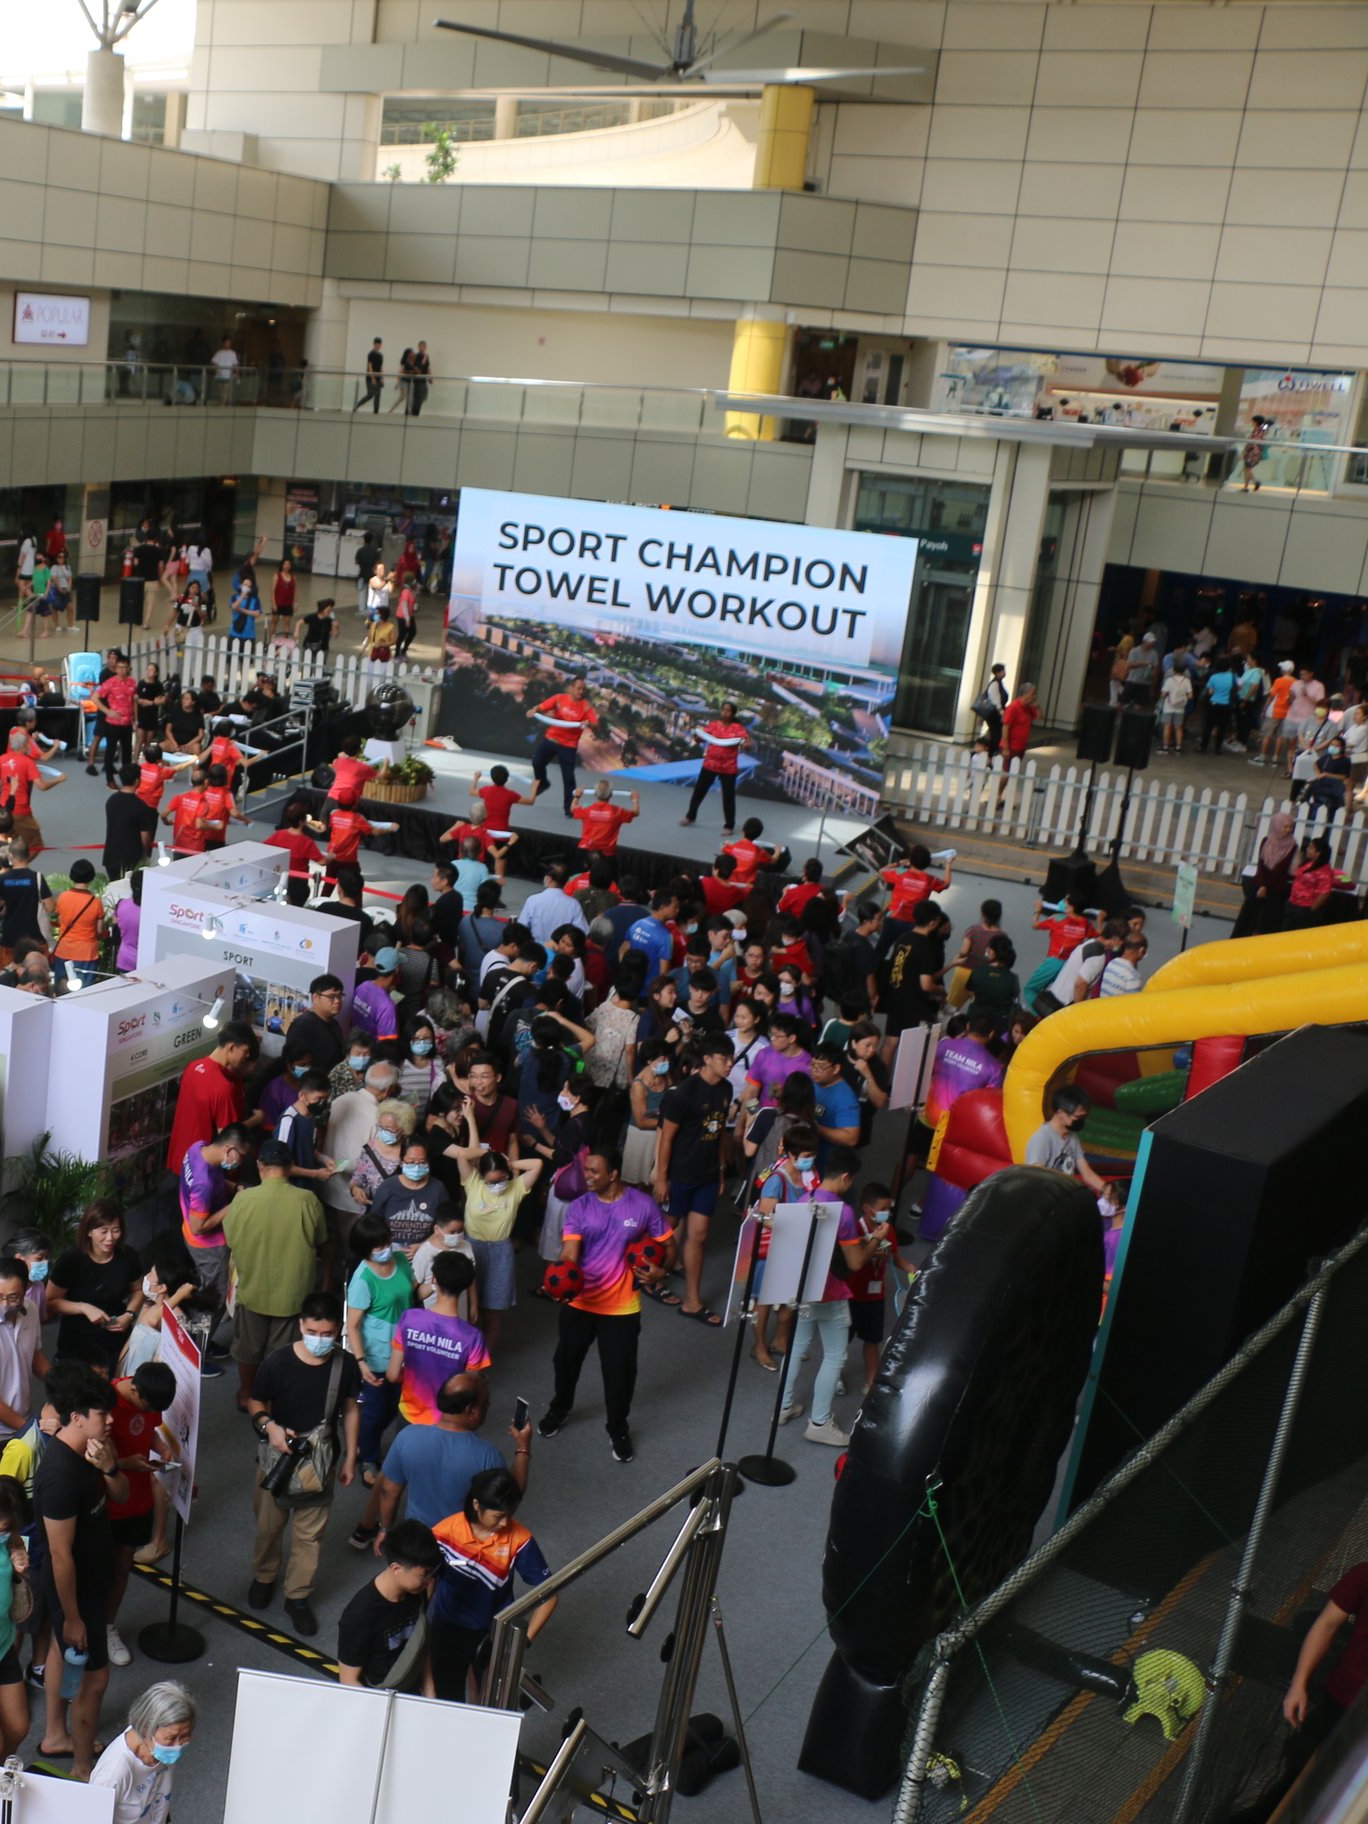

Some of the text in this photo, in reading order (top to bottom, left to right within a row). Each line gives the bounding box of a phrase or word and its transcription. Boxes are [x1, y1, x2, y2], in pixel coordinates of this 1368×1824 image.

[36, 304, 84, 325] POPULAR
[920, 538, 949, 552] Payoh
[498, 520, 870, 595] SPORT CHAMPION
[493, 562, 868, 640] TOWEL WORKOUT
[168, 903, 205, 923] Sport
[223, 950, 254, 967] SPORT
[117, 1013, 147, 1036] Sport
[173, 1027, 203, 1049] GREEN
[944, 1049, 965, 1063] TEAM
[406, 1328, 463, 1353] TEAM NILA
[407, 1340, 460, 1361] SPORT VOLUNTEER
